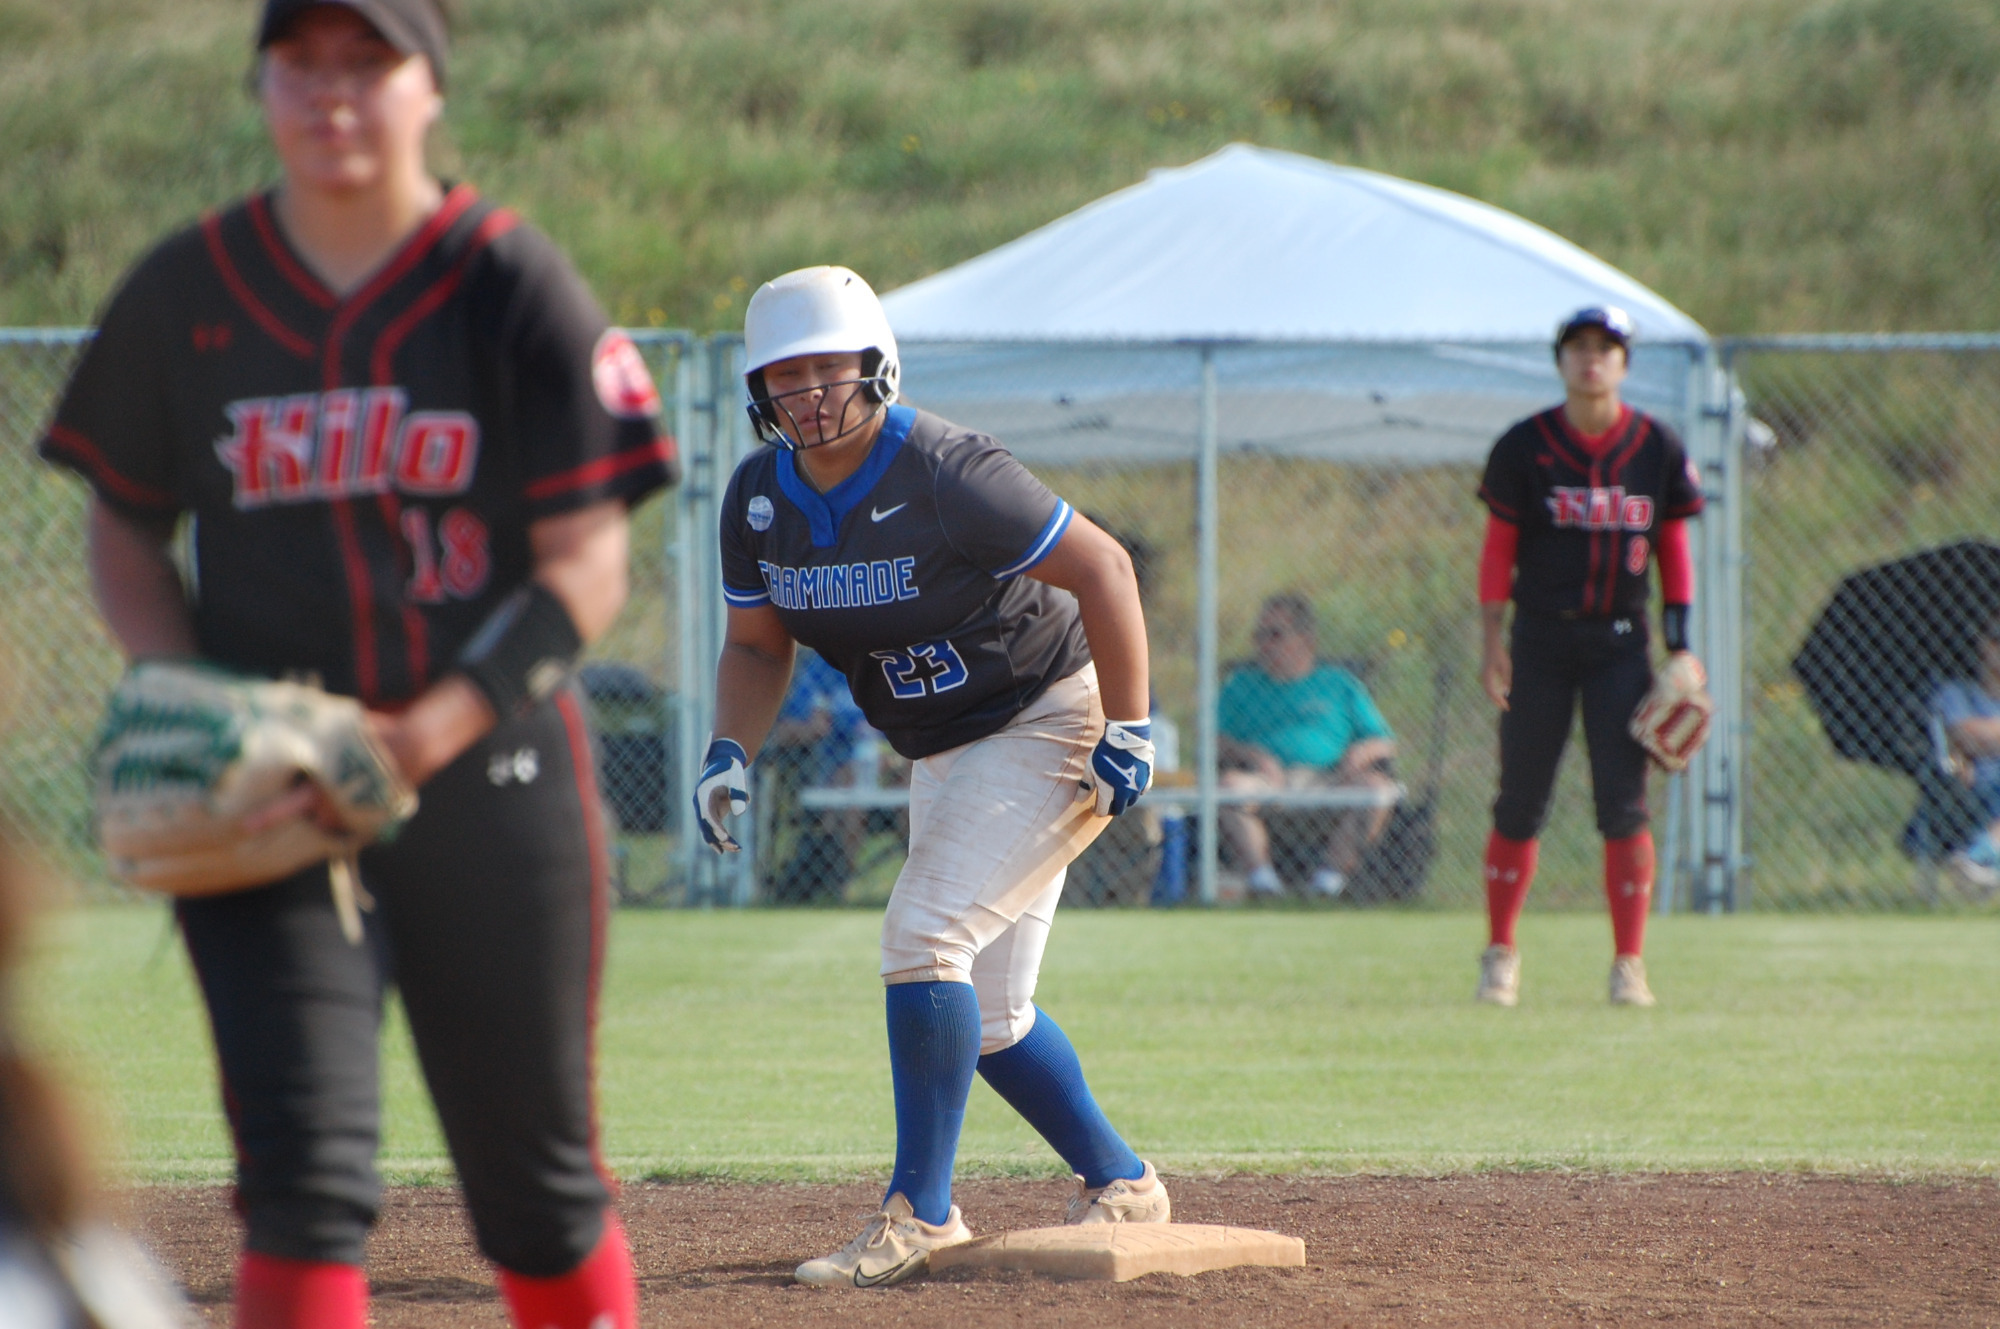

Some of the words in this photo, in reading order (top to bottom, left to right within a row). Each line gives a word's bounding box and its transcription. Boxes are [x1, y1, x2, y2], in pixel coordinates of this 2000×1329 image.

[402, 507, 490, 602] 18
[1626, 534, 1649, 575] 8
[868, 640, 969, 698] 23
